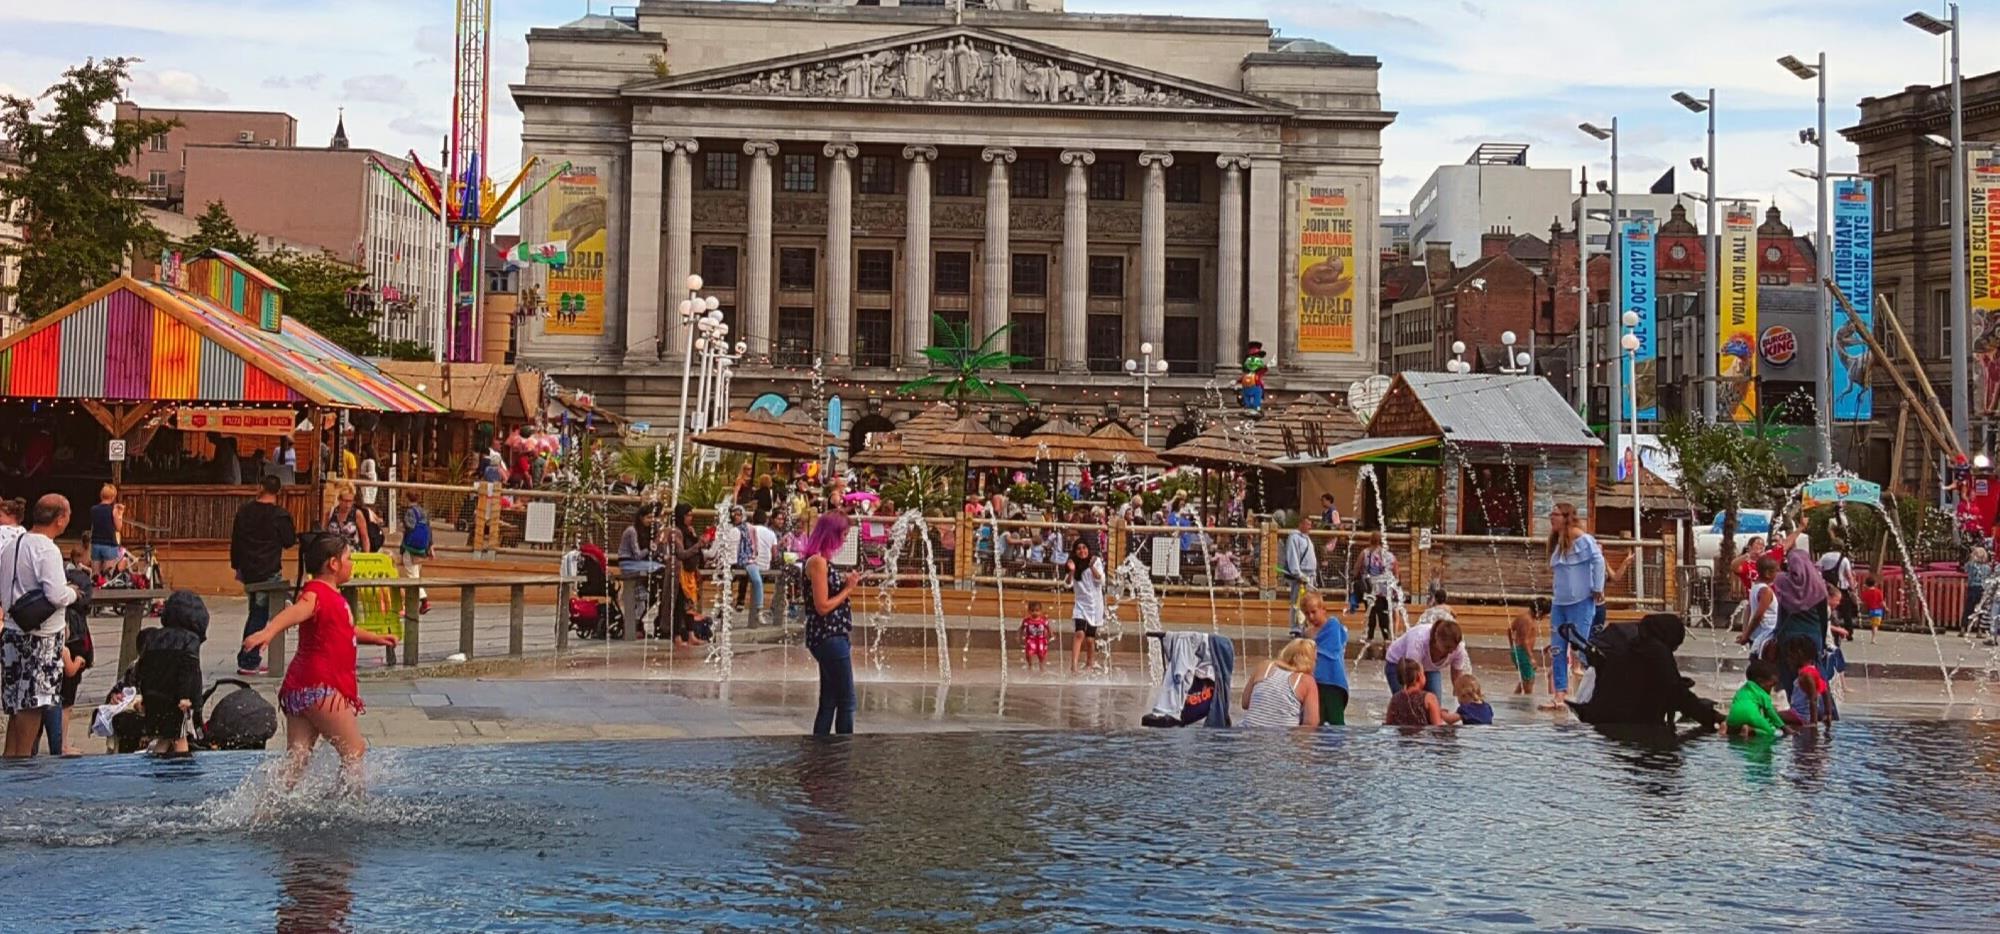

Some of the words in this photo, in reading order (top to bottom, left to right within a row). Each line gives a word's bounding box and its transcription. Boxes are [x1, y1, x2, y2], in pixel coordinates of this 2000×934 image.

[1302, 219, 1329, 232] JOIN
[1332, 219, 1352, 233] THE
[1972, 187, 1987, 251] EXCLUSIVE
[1301, 232, 1353, 246] DINOSAUR
[1854, 215, 1870, 249] ARTS
[1301, 246, 1353, 257] REVOLUTION
[1732, 235, 1747, 263] HALL
[566, 250, 604, 269] ORLD
[1631, 250, 1648, 278] 2017
[1854, 253, 1870, 314] LAKESIDE
[1973, 255, 1988, 299] WORLD
[1631, 280, 1648, 304] OCT
[1732, 266, 1747, 326] WOLLATON
[1301, 297, 1353, 315] WORLD
[1301, 314, 1353, 326] EXCLUSIVE
[1762, 332, 1793, 348] BURGER
[1764, 340, 1794, 358] KING
[225, 416, 241, 425] PIZZA
